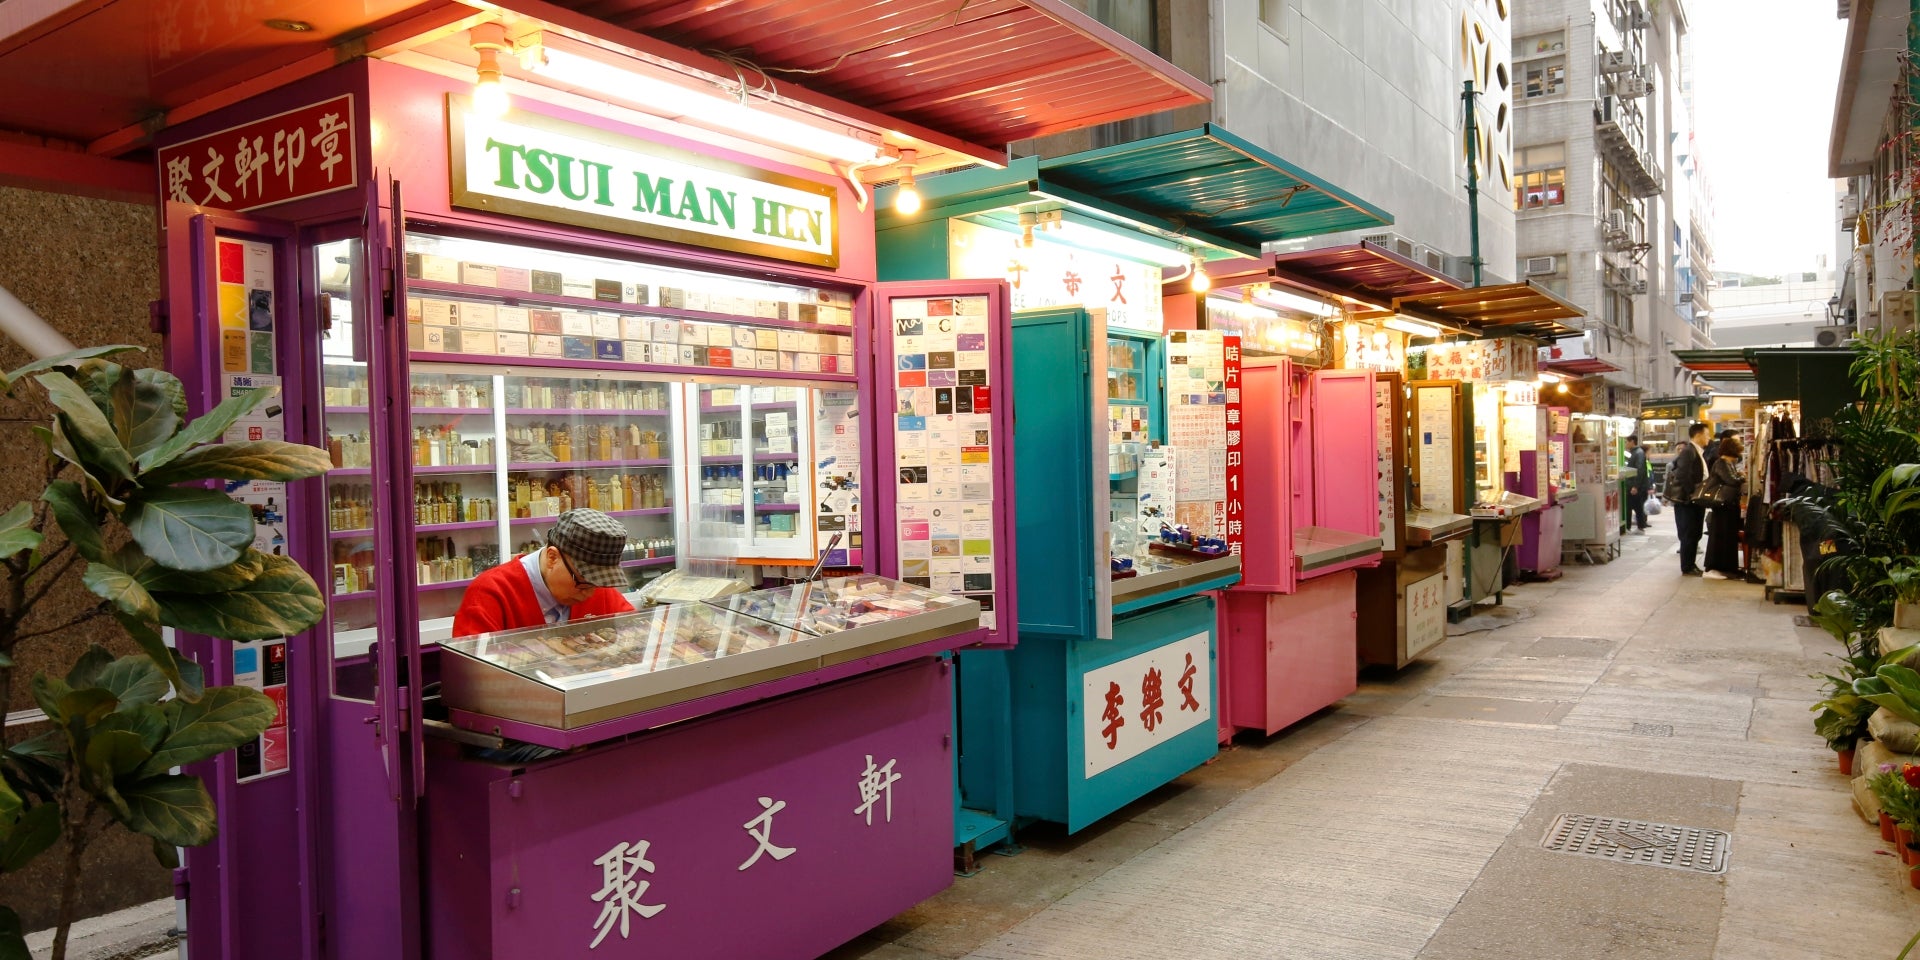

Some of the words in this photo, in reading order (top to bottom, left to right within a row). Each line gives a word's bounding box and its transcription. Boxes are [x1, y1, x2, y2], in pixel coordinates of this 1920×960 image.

[167, 112, 348, 206] 聚文軒印章
[485, 137, 615, 207] TSUI
[632, 171, 737, 229] MAN
[752, 196, 823, 246] HIN
[232, 389, 253, 397] SHAR
[1225, 346, 1243, 577] 咭片圖章膠印1小時有
[1102, 652, 1199, 750] 李樂文
[590, 755, 902, 949] 聚文軒
